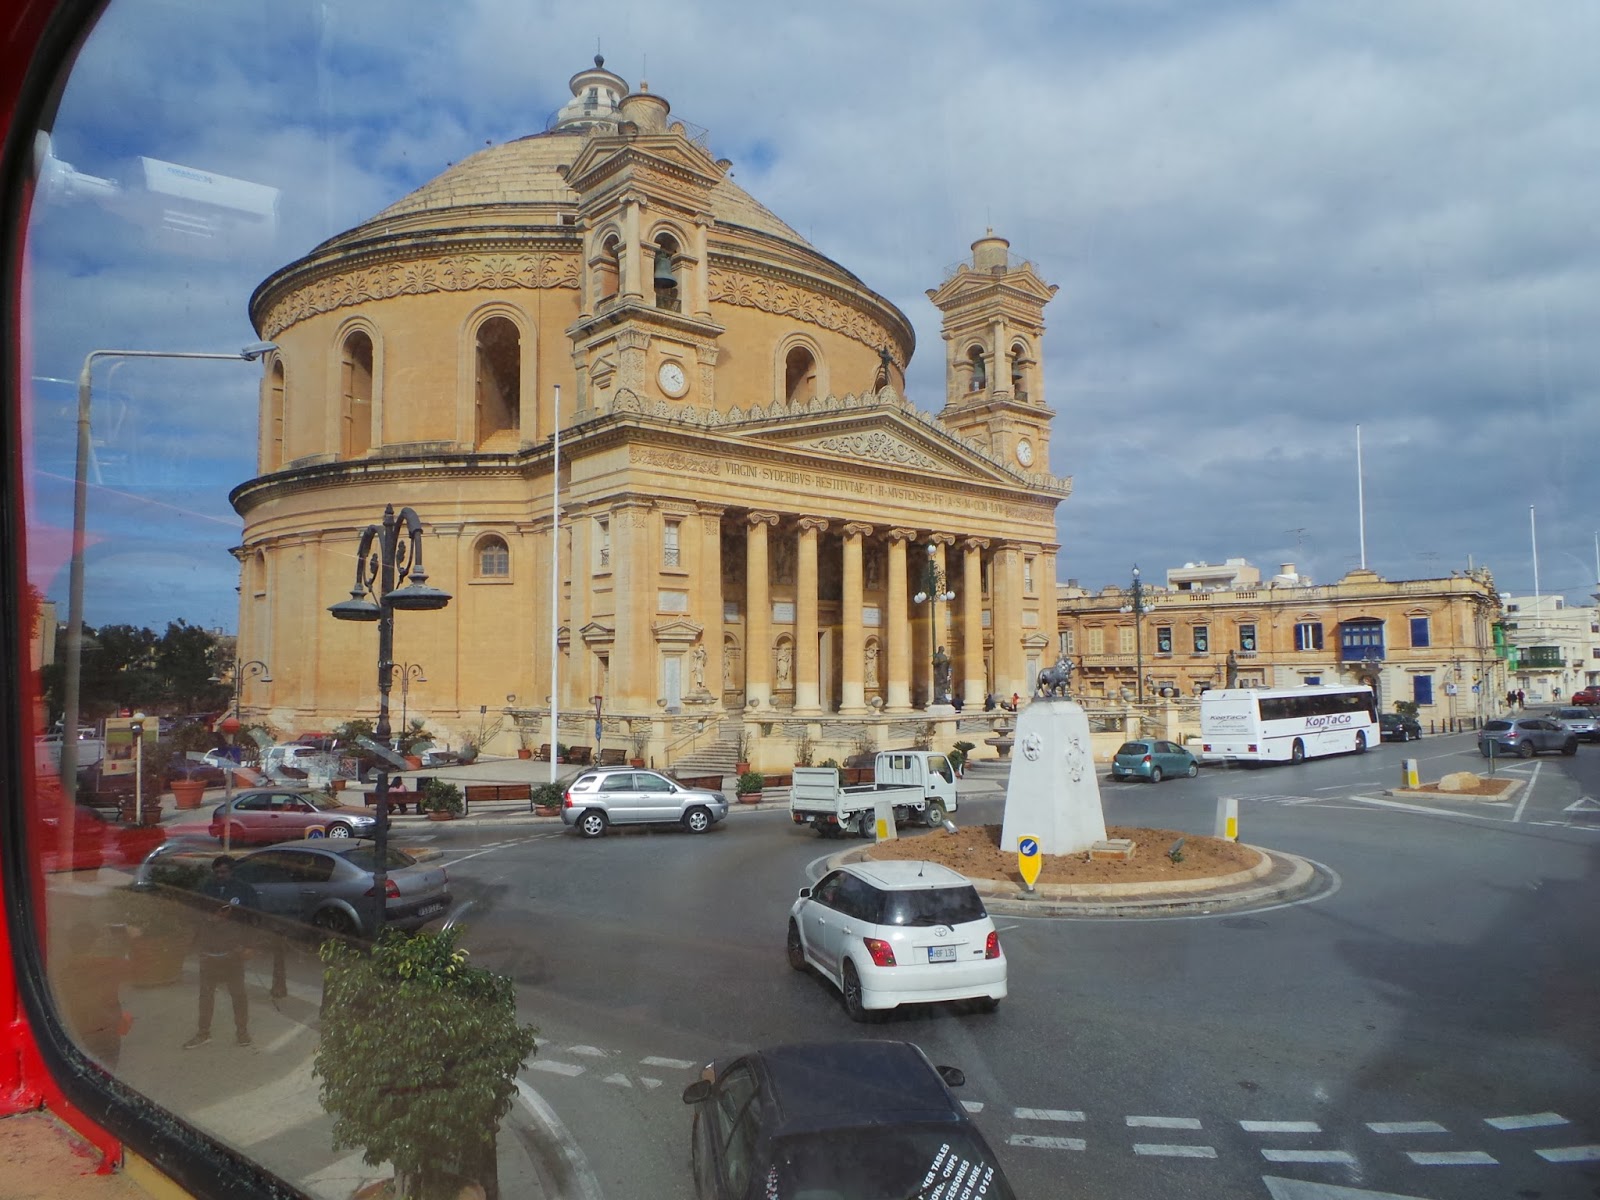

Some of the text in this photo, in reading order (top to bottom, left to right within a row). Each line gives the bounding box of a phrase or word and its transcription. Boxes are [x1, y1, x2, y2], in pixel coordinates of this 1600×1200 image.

[725, 461, 757, 478] VIRGINI
[1305, 715, 1351, 727] KopTaCo
[931, 1143, 950, 1171] TABLES
[943, 1154, 958, 1178] CHIPS
[979, 1167, 994, 1194] 0154
